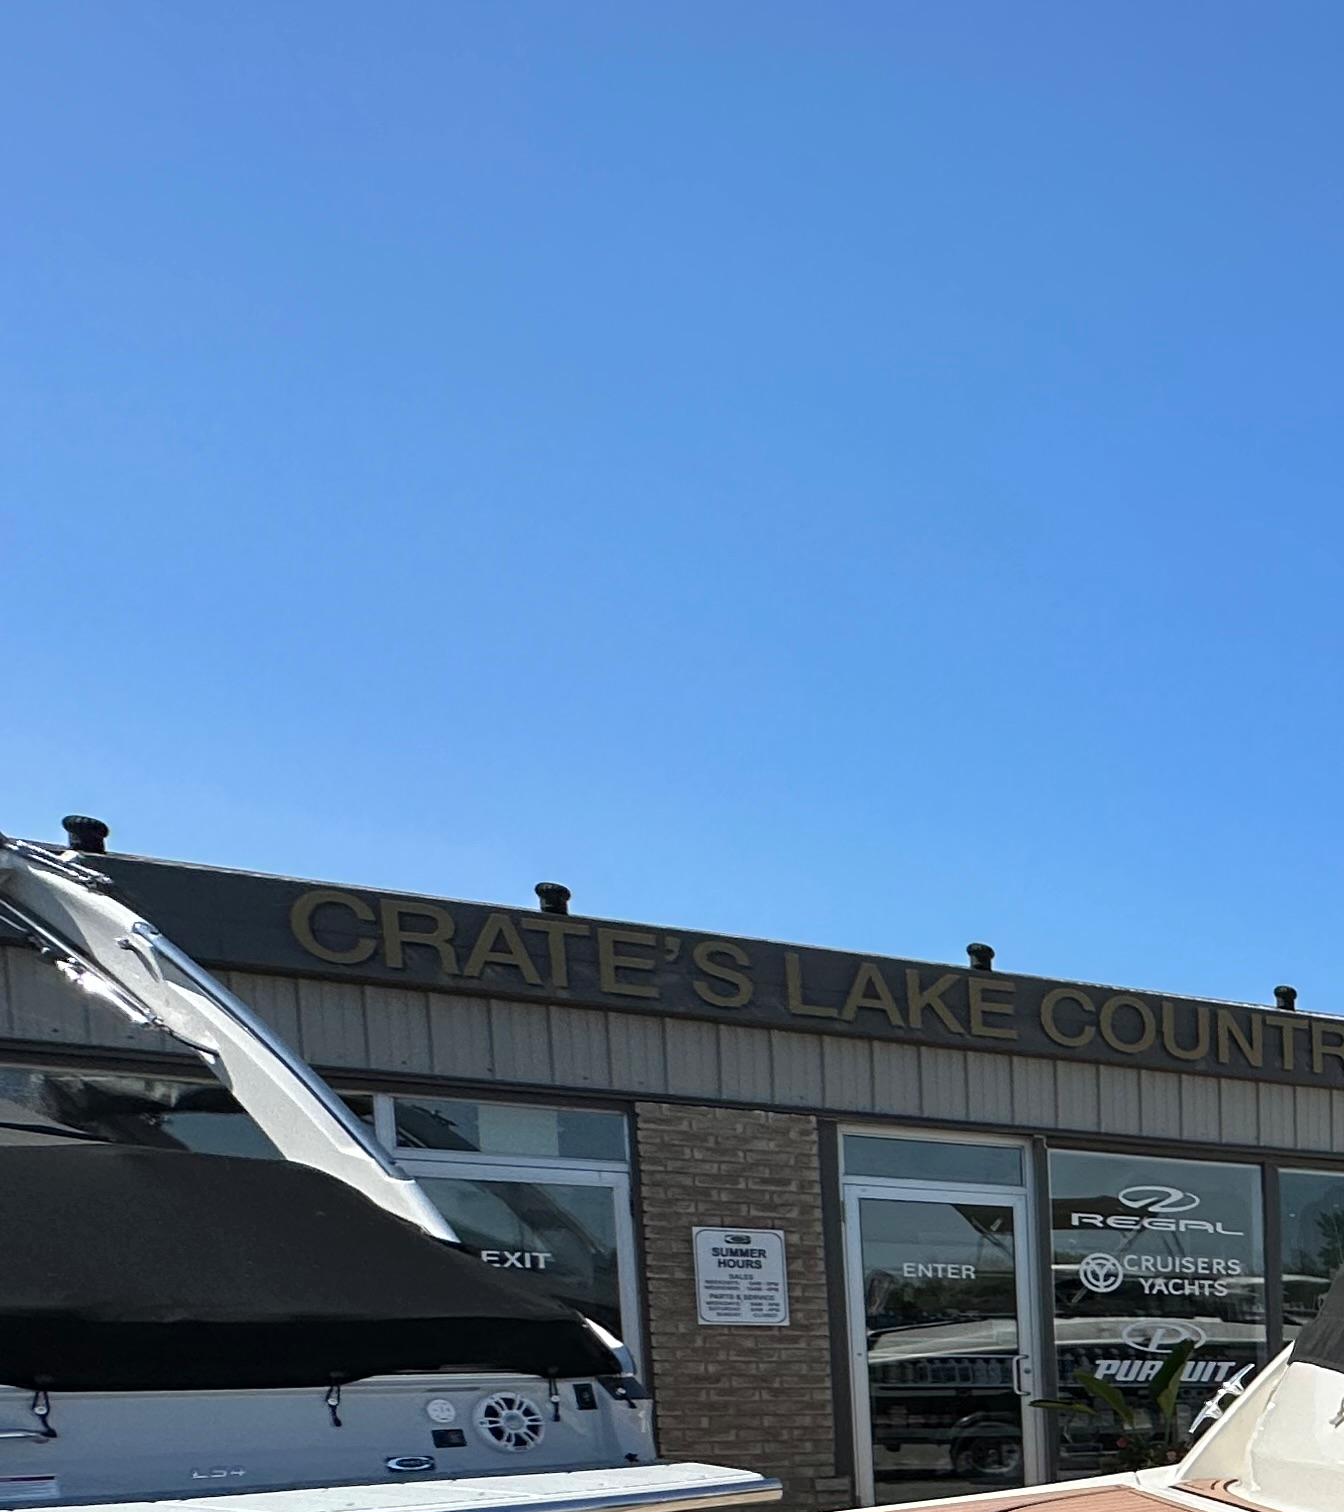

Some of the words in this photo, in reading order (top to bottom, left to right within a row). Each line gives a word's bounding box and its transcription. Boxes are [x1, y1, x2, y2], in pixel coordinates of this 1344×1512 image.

[291, 890, 754, 1009] CRATE'S
[785, 951, 1019, 1040] LAKE
[1071, 1213, 1244, 1236] REGAL
[481, 1250, 552, 1269] EXIT
[712, 1247, 767, 1259] SUMMER
[718, 1259, 762, 1270] HOURS
[903, 1262, 976, 1279] ENTER
[1123, 1255, 1241, 1275] CRUISERS
[1138, 1277, 1228, 1296] YACHTS
[1095, 1360, 1236, 1382] PURUIT
